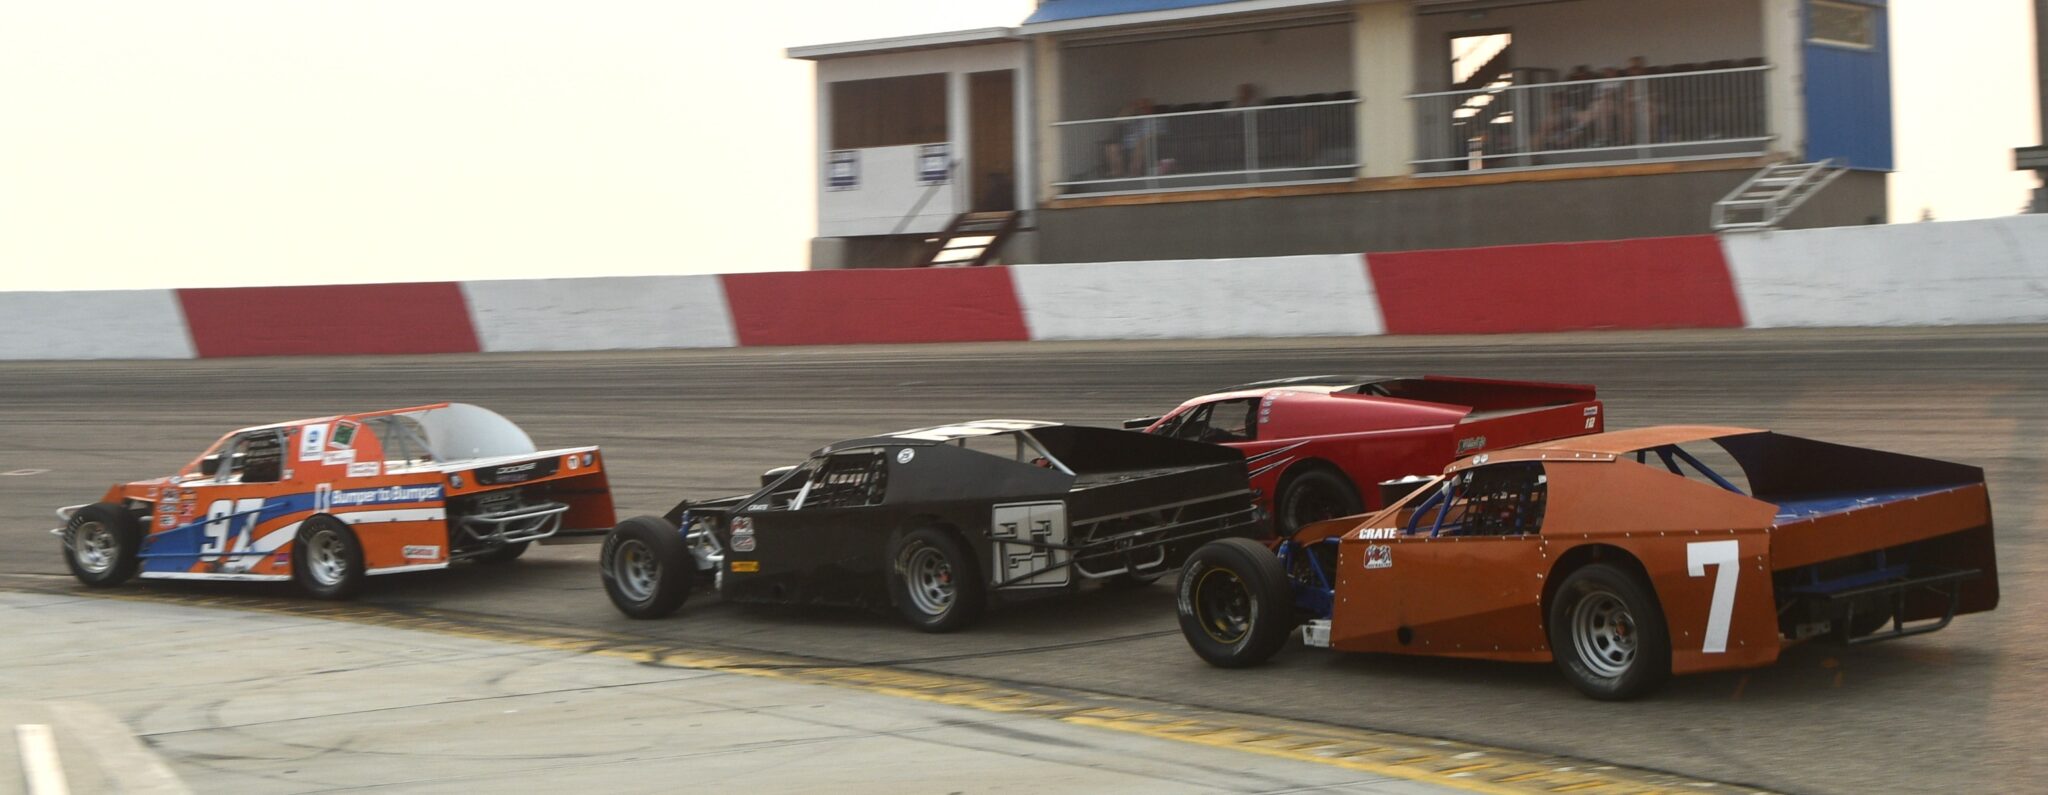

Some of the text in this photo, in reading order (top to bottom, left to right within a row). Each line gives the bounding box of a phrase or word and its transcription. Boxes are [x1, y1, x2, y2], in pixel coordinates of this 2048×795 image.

[332, 485, 443, 505] Bumper to Bumper
[200, 498, 265, 567] 97
[1358, 527, 1398, 540] CRATE
[1686, 540, 1740, 653] 7
